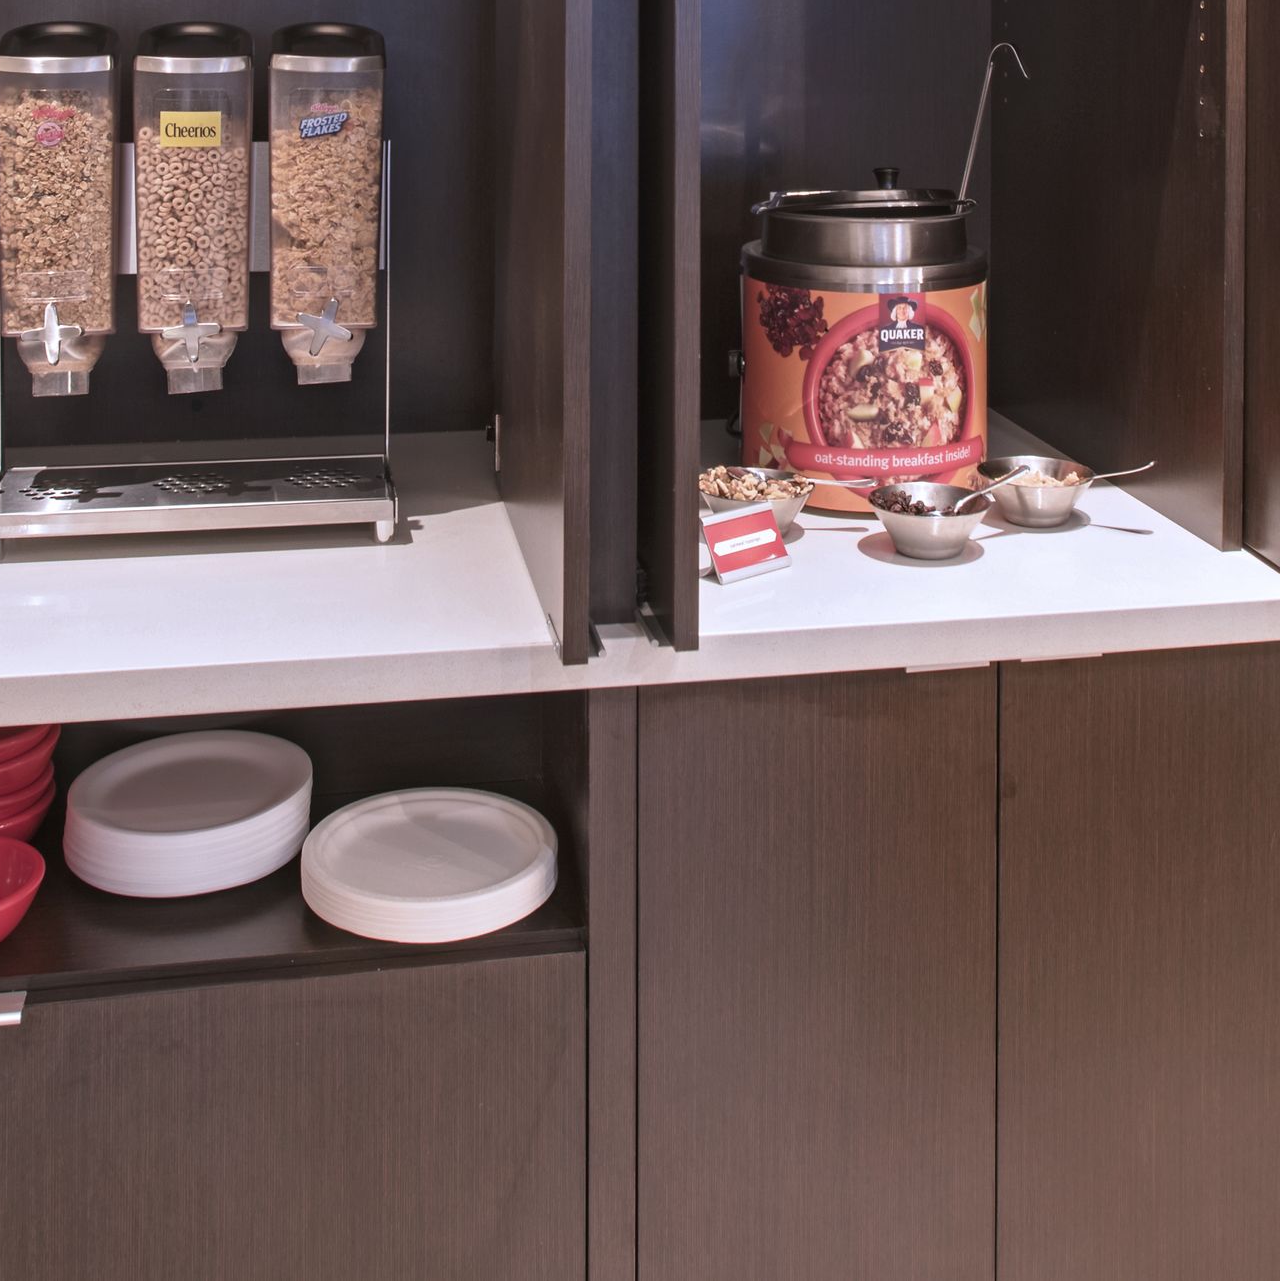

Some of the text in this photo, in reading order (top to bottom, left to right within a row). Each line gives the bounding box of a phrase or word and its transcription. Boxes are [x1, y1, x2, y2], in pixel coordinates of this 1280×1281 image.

[300, 113, 348, 129] FROSTED
[165, 123, 216, 138] Cheerios
[301, 123, 342, 138] FLAKES
[880, 328, 925, 343] QUAKER
[814, 446, 971, 470] oat-standing breakfast inside!
